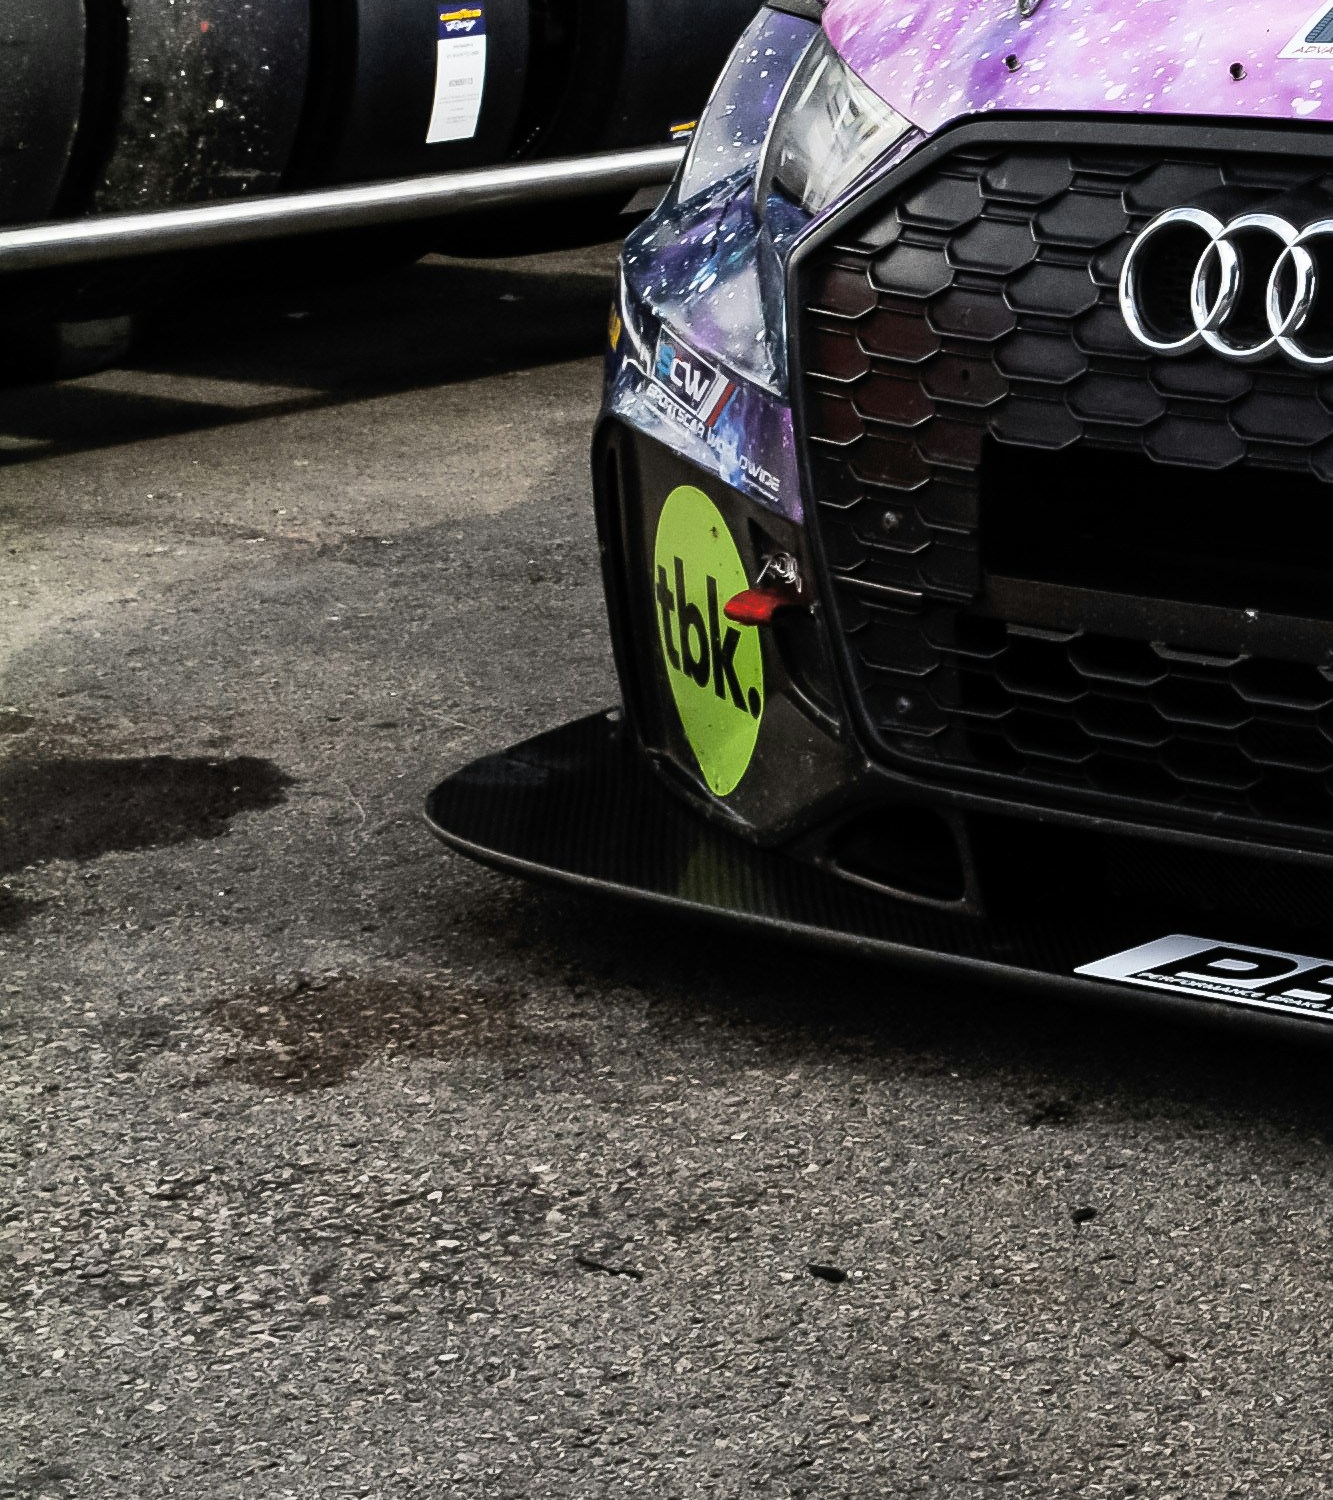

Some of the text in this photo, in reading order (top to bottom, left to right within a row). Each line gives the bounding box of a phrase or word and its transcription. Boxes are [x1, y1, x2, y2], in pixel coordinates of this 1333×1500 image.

[657, 344, 710, 402] SCW
[656, 556, 761, 720] tbk.
[1137, 972, 1266, 999] PERFORMANCE
[1266, 995, 1326, 1010] BRAKE
